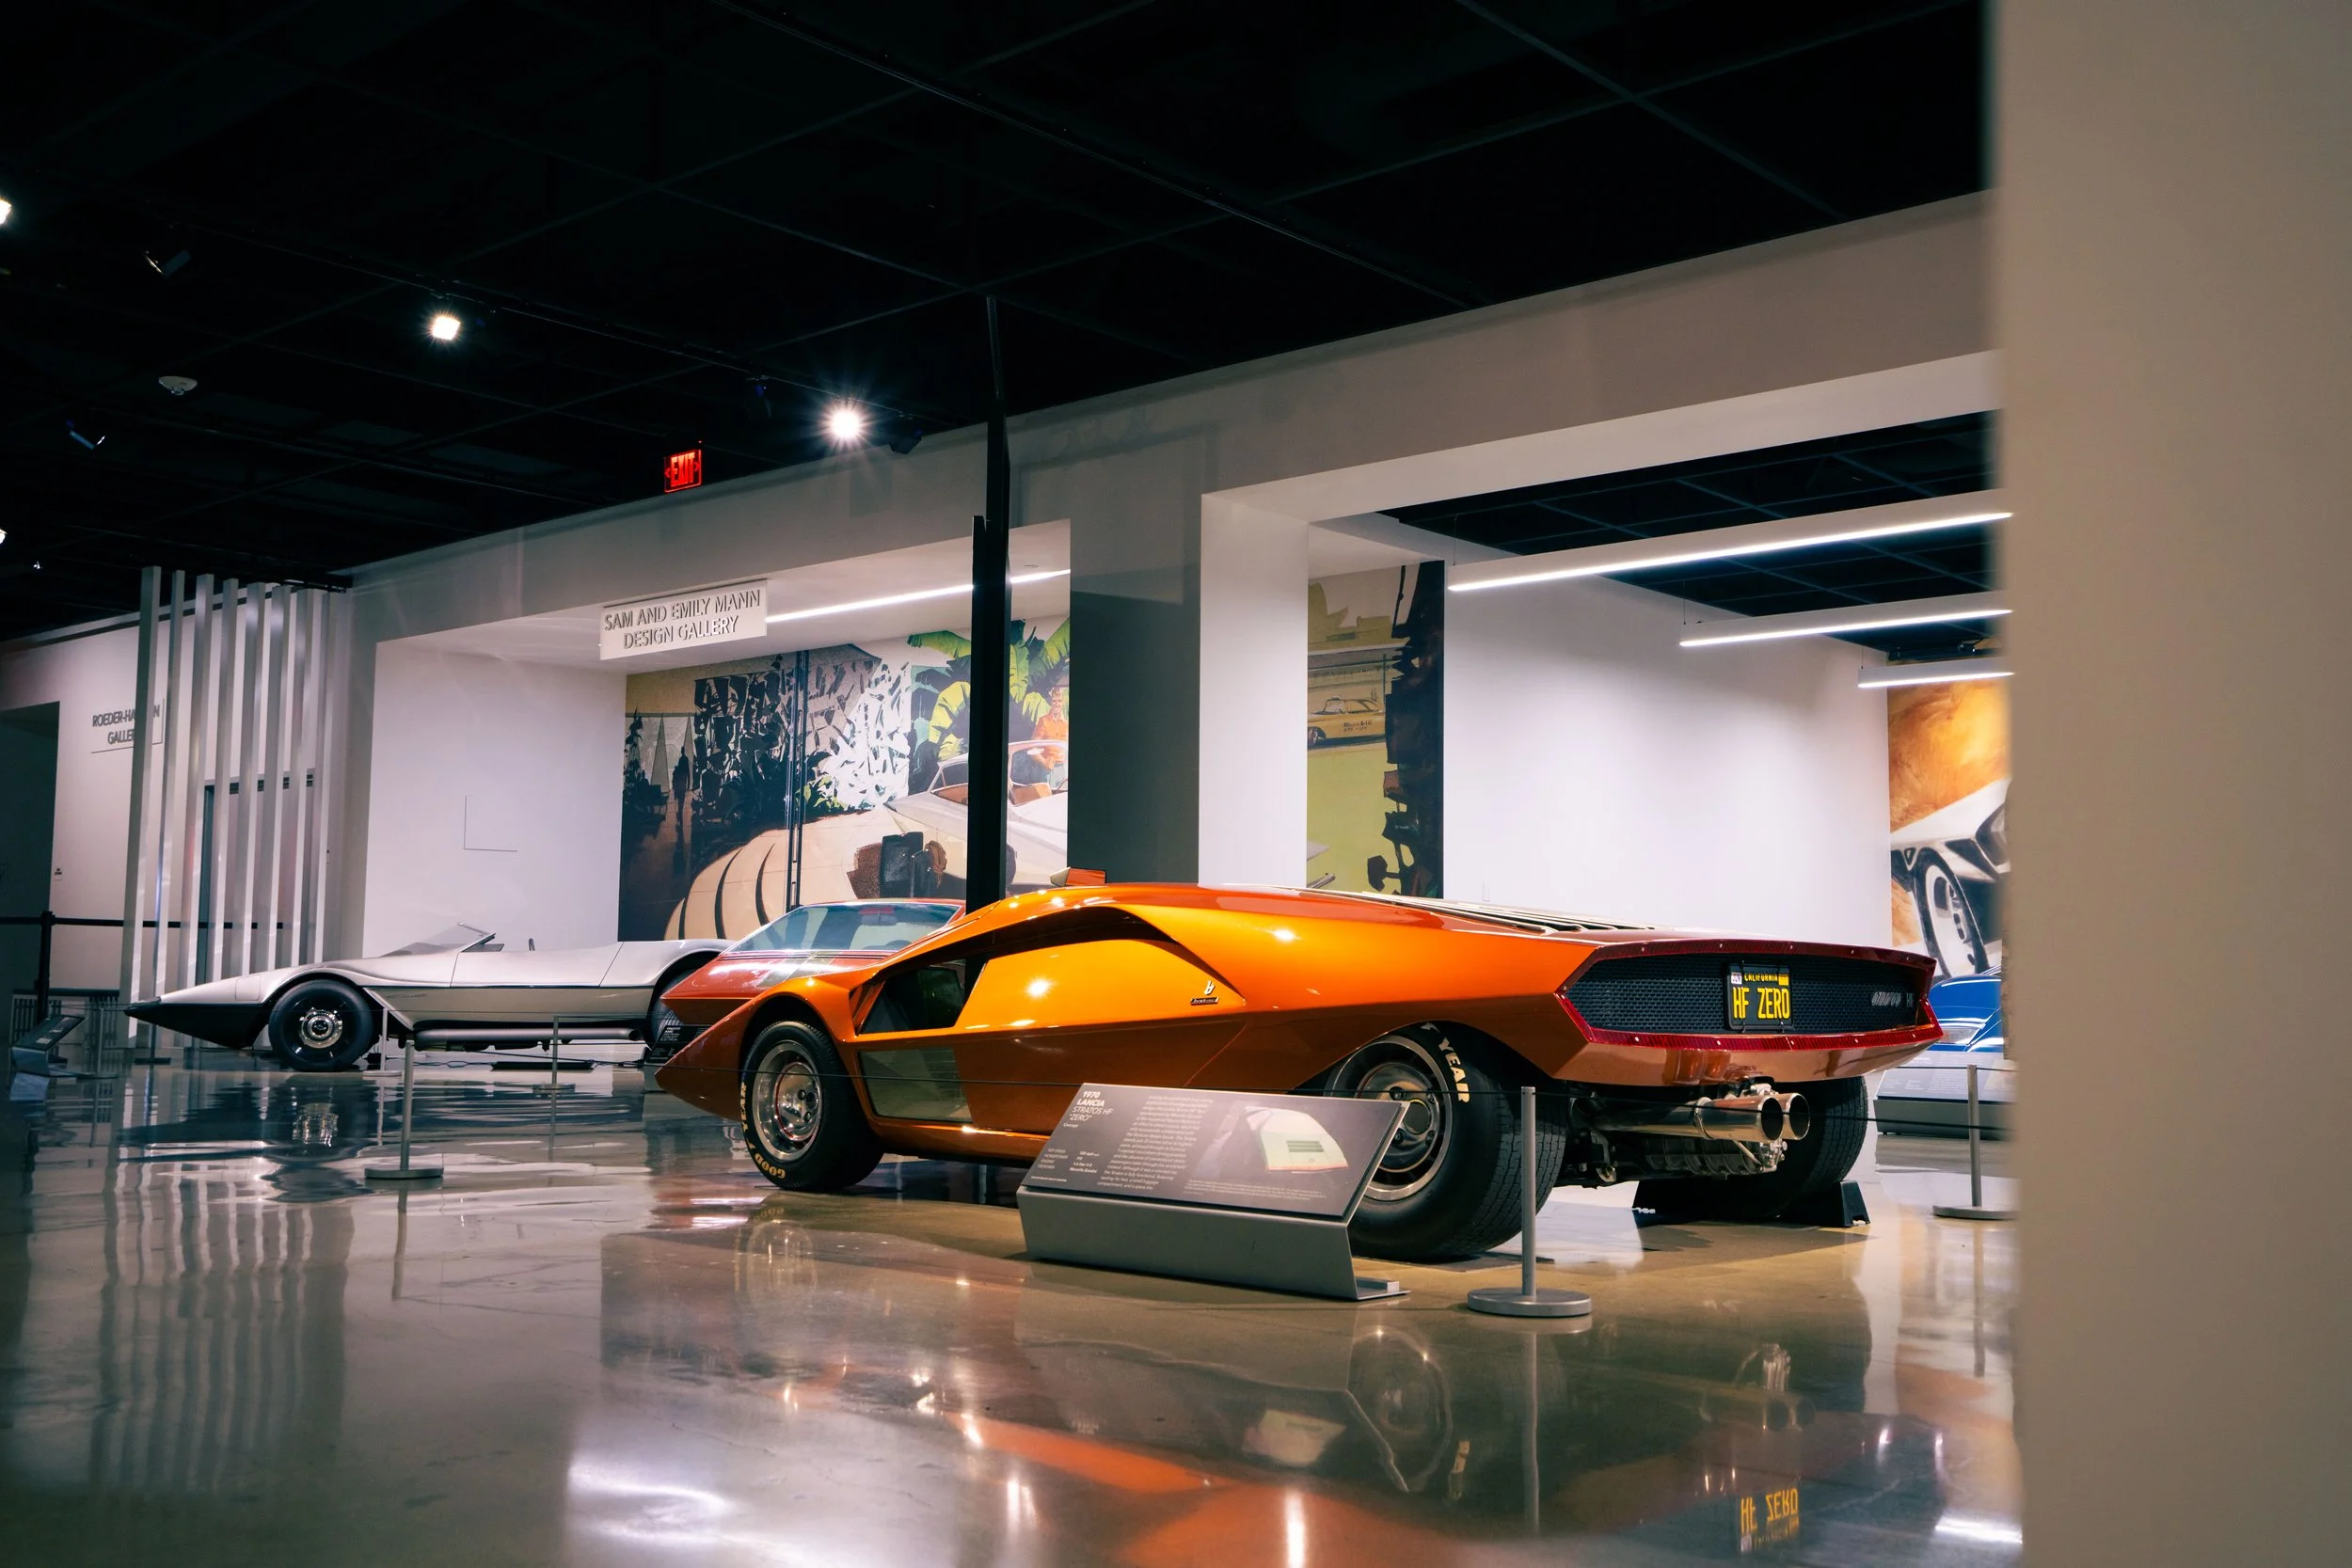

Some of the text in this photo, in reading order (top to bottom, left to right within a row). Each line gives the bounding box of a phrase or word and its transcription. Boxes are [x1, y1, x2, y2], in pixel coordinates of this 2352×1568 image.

[671, 452, 695, 487] EXIT
[604, 589, 760, 631] SAM AND EMILY MANN
[624, 615, 739, 649] DESIGN GALLERY
[1744, 973, 1778, 982] CALIFORNIA
[1732, 987, 1790, 1019] HF ZERO
[1073, 1106, 1102, 1115] STRATOS
[1076, 1099, 1105, 1107] LANCIA
